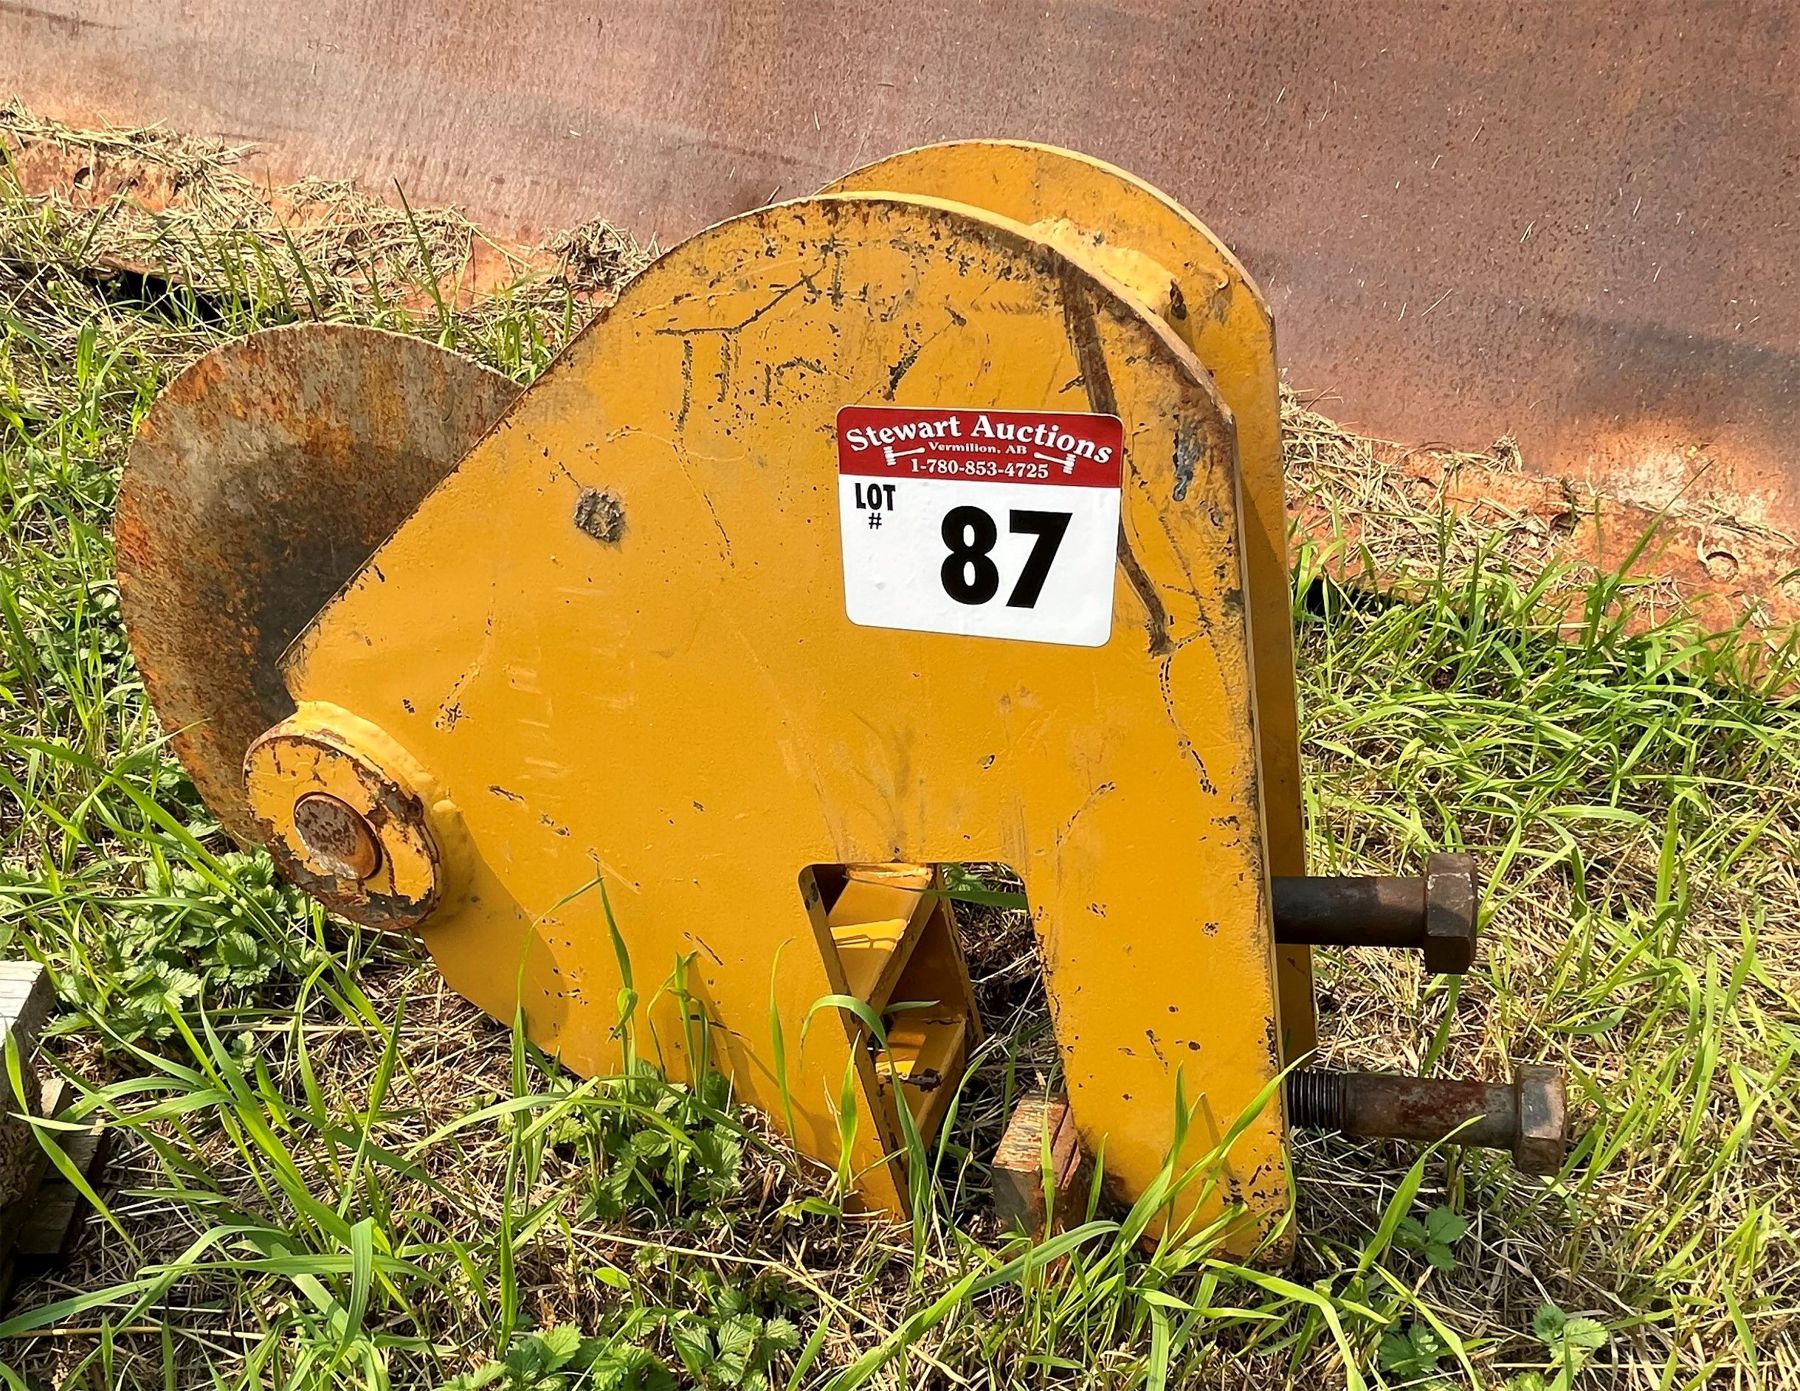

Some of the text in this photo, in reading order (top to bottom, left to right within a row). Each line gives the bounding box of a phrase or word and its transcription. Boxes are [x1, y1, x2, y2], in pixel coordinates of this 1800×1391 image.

[846, 415, 1113, 464] Stewart Auctions
[928, 441, 1028, 455] Vermilion, AB
[910, 458, 1049, 479] 1-780-853-4725
[854, 482, 896, 511] LOT
[868, 512, 882, 530] #
[940, 505, 1073, 609] 87
